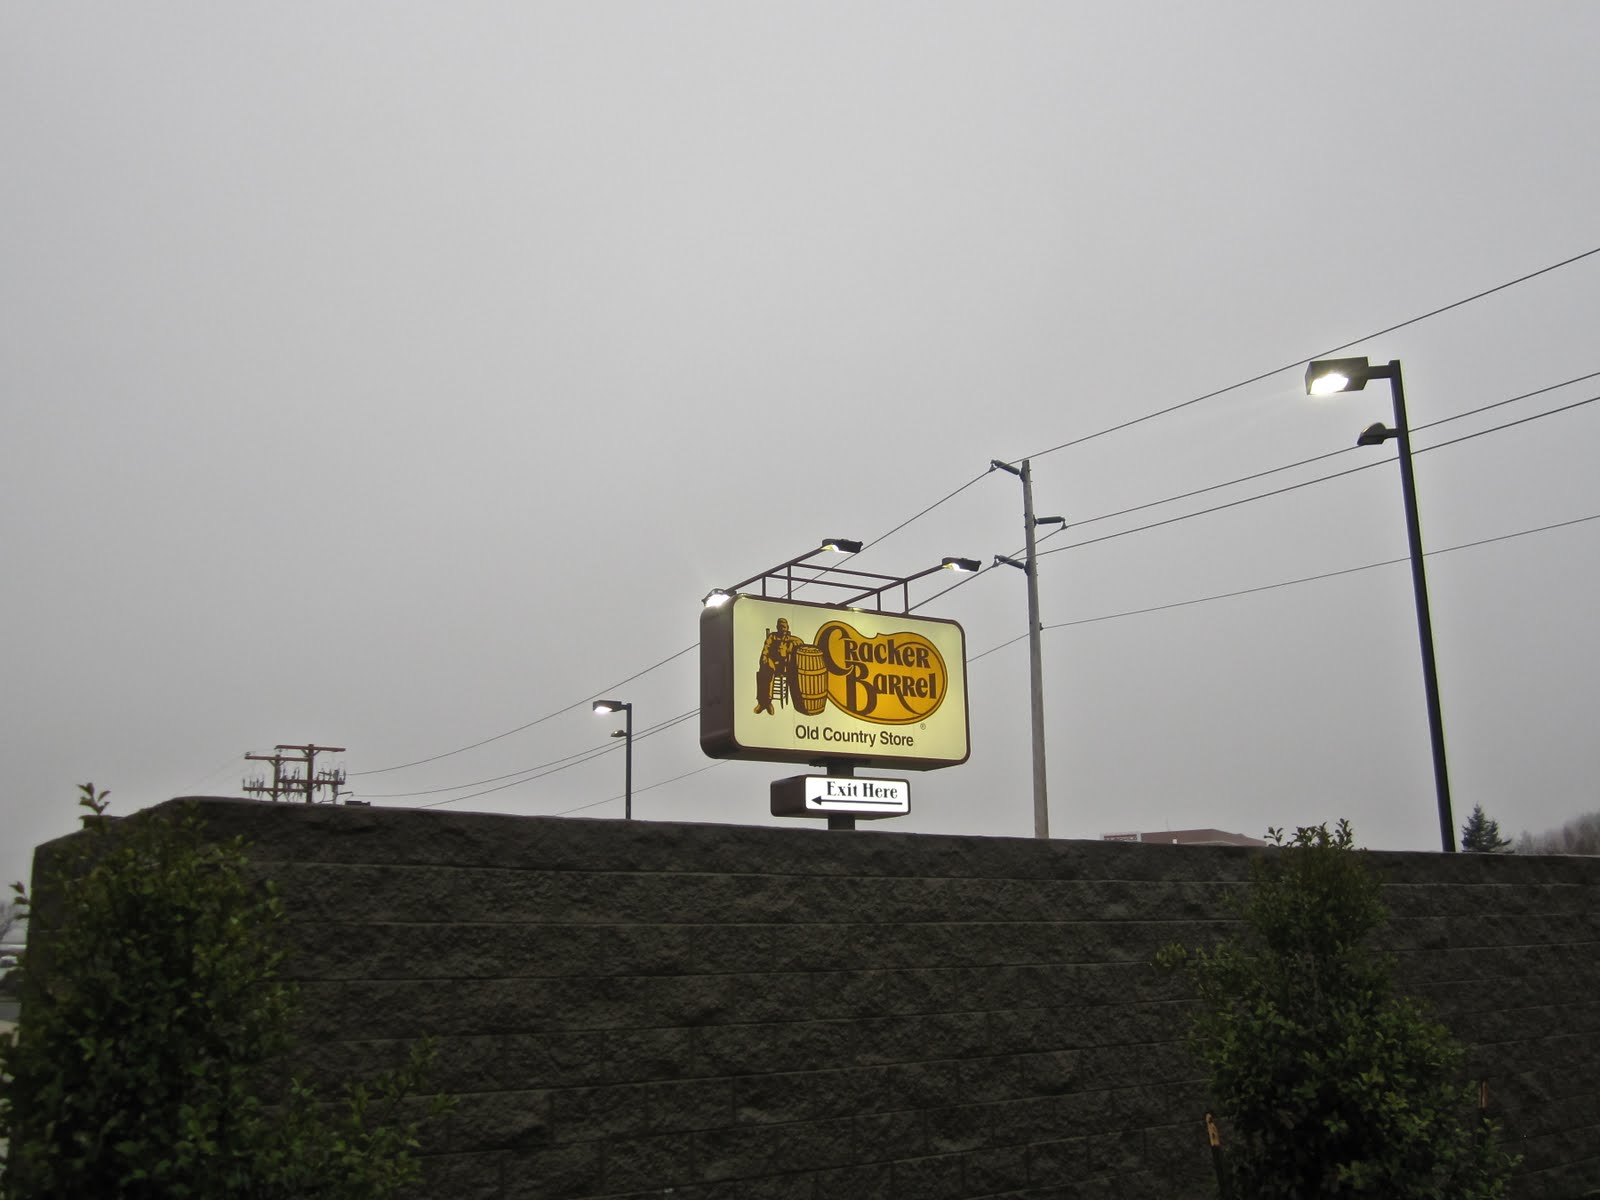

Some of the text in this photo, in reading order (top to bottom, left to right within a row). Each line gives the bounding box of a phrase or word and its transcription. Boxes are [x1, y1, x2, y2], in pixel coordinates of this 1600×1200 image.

[795, 725, 914, 747] Old Country Store
[827, 781, 898, 799] Exit Here
